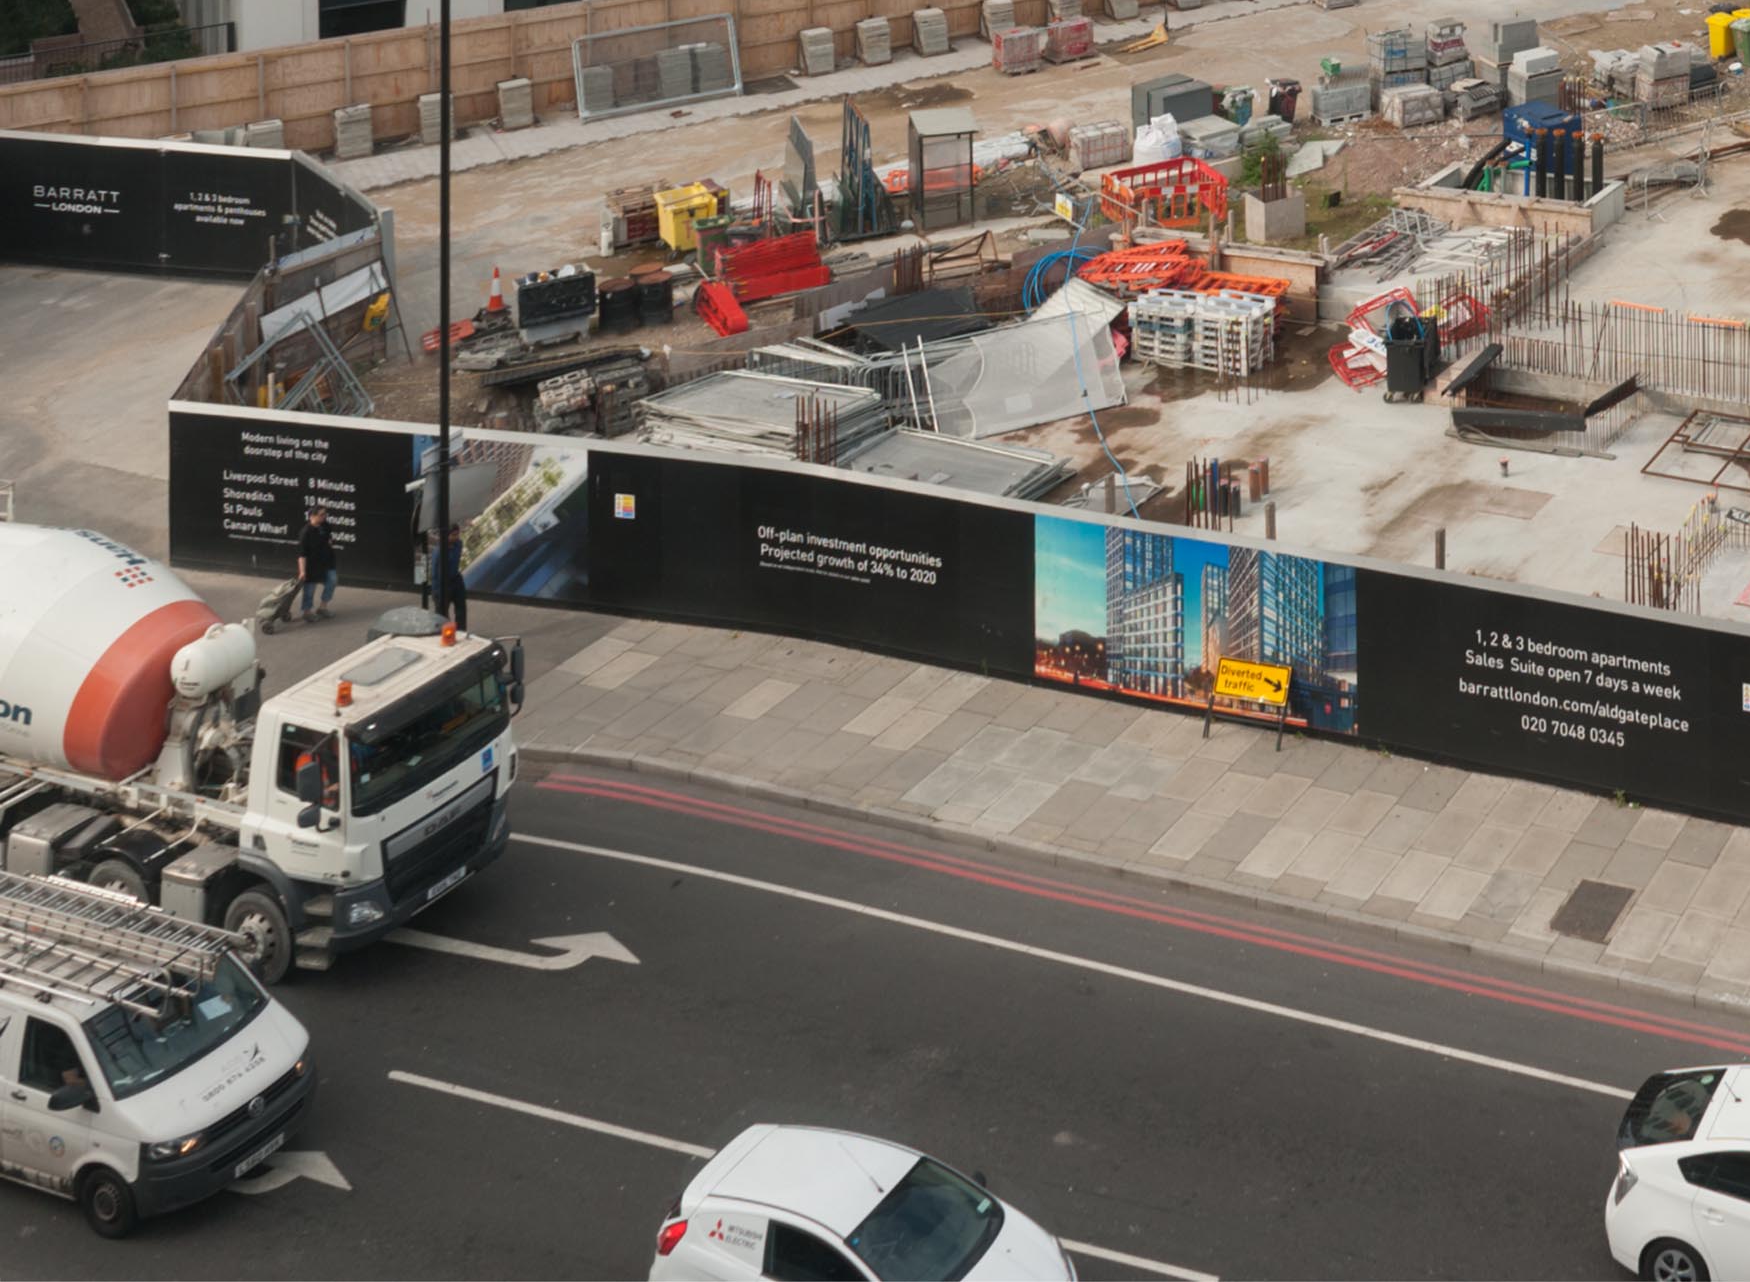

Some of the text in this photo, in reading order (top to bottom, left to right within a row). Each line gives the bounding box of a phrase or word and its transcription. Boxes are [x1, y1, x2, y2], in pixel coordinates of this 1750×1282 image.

[33, 185, 120, 203] BARRATT
[218, 195, 250, 205] bedroom
[52, 202, 102, 214] LONDON
[173, 202, 216, 215] apartments
[225, 205, 267, 218] penthouses
[195, 214, 245, 226] available now
[241, 432, 329, 449] Modern living on the
[244, 446, 328, 464] doorstep of the city
[223, 470, 299, 487] Liverpool Street
[308, 478, 356, 493] 8 Minutes
[223, 488, 275, 502] Shoreditch
[304, 495, 356, 511] 10 Minutes
[223, 504, 263, 517] St Pauls
[223, 519, 289, 535] Canary Wharf
[757, 525, 943, 568] Off-plan investment opportunities
[760, 543, 814, 562] Projected
[817, 553, 855, 570] growth
[857, 560, 869, 572] of
[870, 561, 894, 577] 34%
[896, 568, 908, 579] to
[910, 569, 937, 585] 2020
[1490, 631, 1499, 646] 2
[1501, 634, 1513, 649] &
[1516, 636, 1524, 651] 3
[1527, 638, 1588, 662] bedroom
[1591, 652, 1672, 676] apartments
[1220, 664, 1262, 680] Diverted
[1465, 649, 1682, 701] Sales Suite open 7 days a week
[1224, 679, 1255, 692] traffic
[1459, 677, 1690, 732] barrattlondon.com/aldgateplace
[1521, 715, 1625, 747] 020 7048 0345
